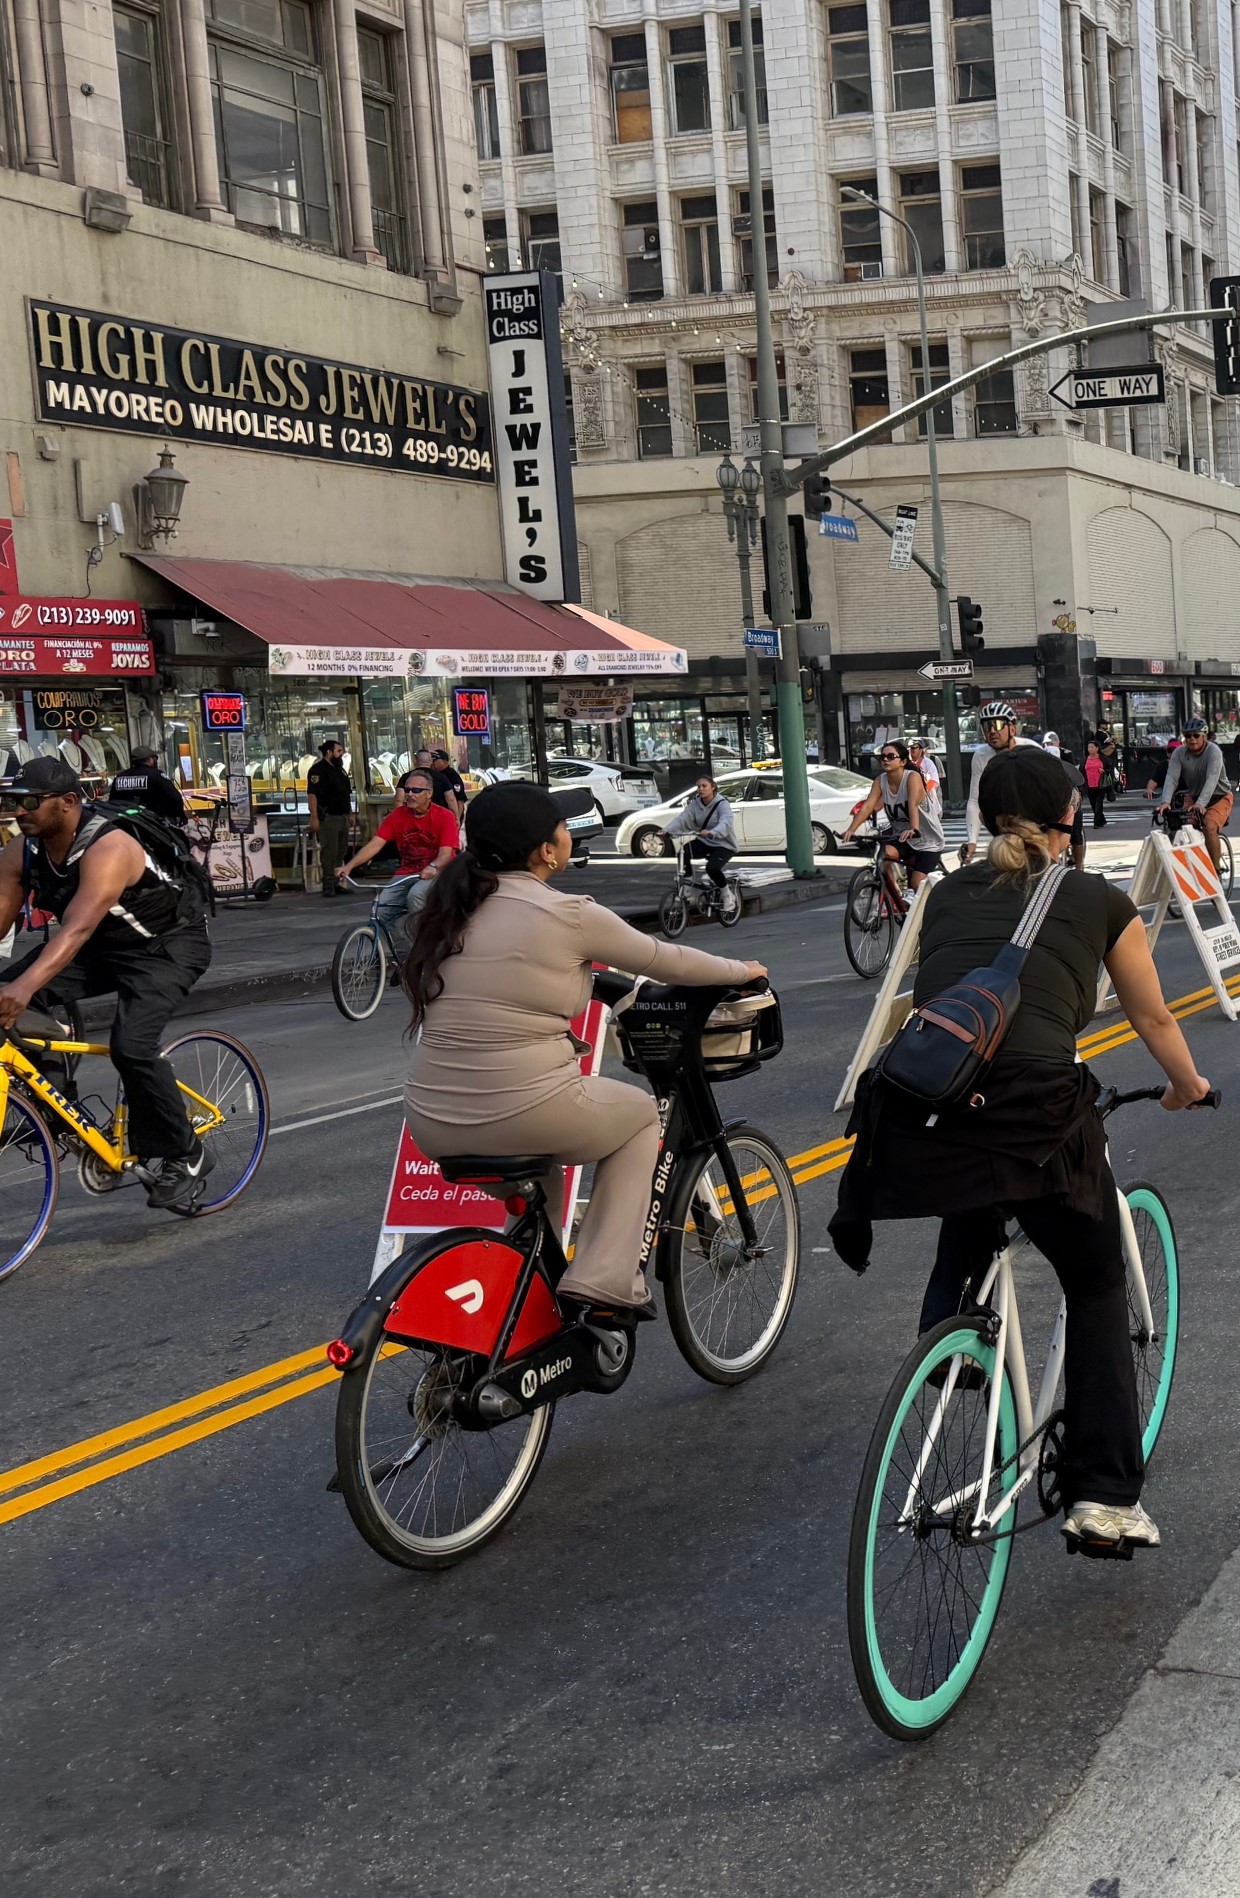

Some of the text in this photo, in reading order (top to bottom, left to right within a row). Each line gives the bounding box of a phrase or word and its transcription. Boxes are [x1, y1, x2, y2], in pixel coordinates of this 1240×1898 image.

[492, 288, 536, 313] High
[492, 317, 538, 338] Class
[34, 308, 477, 441] HIGH CLASS JEWEL'S
[1075, 376, 1153, 399] ONE WAY
[46, 380, 183, 426] MAYOREO
[341, 427, 392, 457] (213)
[402, 438, 492, 472] 489-9294
[37, 606, 136, 625] (213) 239-9091
[44, 639, 84, 648] FINANCIACIÓN
[93, 641, 102, 649] 0%
[748, 631, 774, 646] Broadway
[56, 649, 94, 658] A 12 MESES
[111, 643, 149, 652] REPARAMOS
[111, 654, 150, 668] JOYAS
[306, 650, 395, 661] HIGH CLASS JEWELS
[359, 664, 393, 672] FINANCING
[457, 692, 487, 710] WE BUY
[44, 710, 97, 727] ORO
[212, 711, 239, 724] ORO
[460, 715, 487, 730] GOLD
[116, 777, 146, 790] SECURITY
[651, 1002, 674, 1010] CALL
[675, 1002, 687, 1010] 511
[36, 1074, 94, 1133] TREK
[405, 1160, 441, 1175] Wait
[400, 1185, 439, 1199] Ceda
[443, 1184, 459, 1200] el
[640, 1151, 674, 1262] Metro Bike
[540, 1356, 572, 1386] Metro
